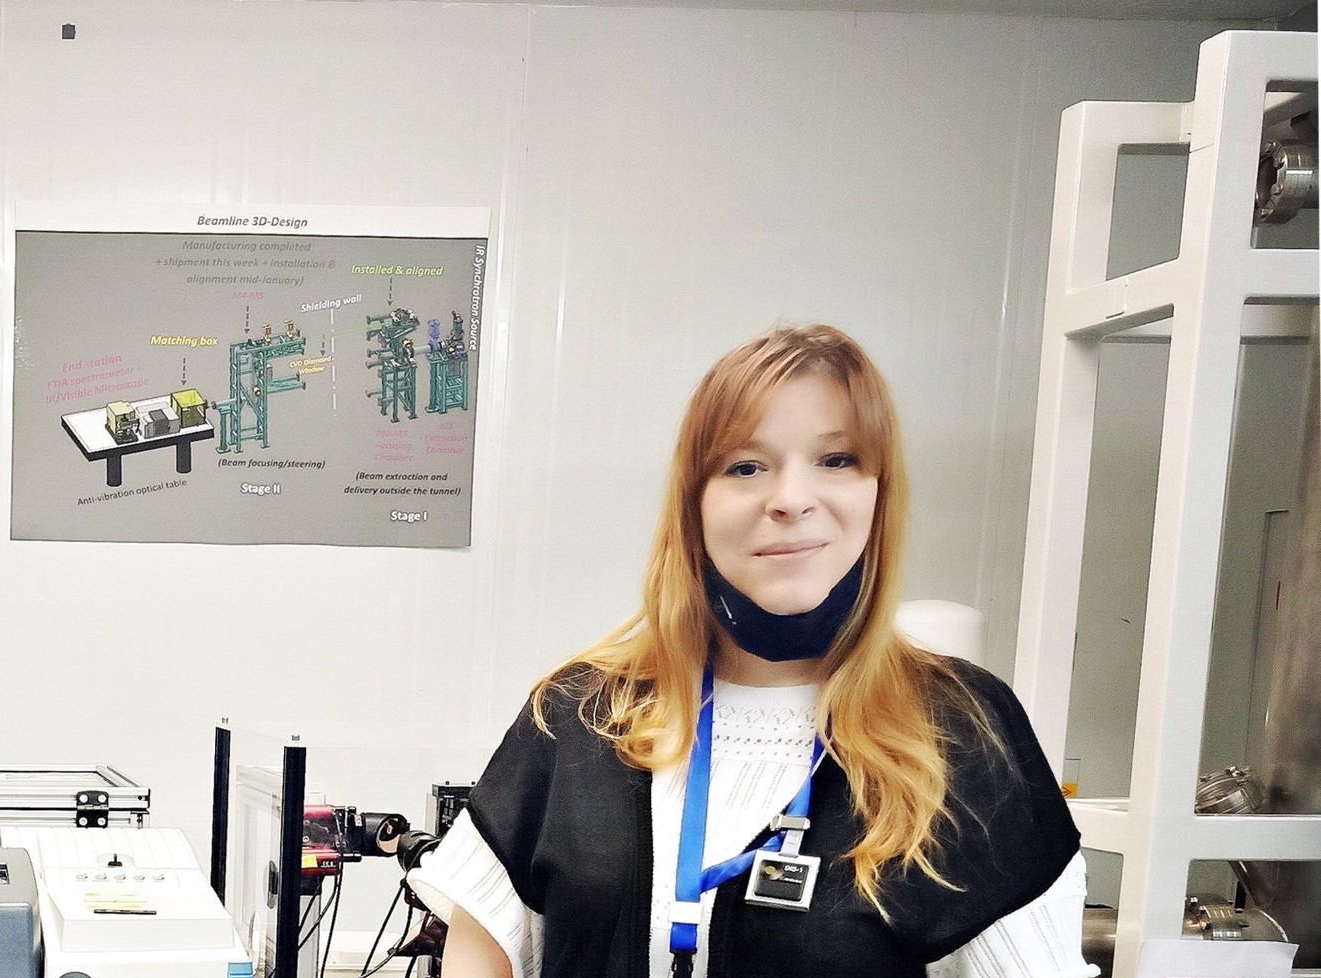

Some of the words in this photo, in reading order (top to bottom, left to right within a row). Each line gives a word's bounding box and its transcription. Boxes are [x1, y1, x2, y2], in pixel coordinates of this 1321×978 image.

[197, 216, 249, 226] Beamline
[252, 216, 308, 229] 3D-Design
[182, 241, 257, 252] Manufacturing
[259, 241, 311, 252] completed
[475, 245, 485, 256] IR
[163, 258, 210, 270] shipment
[213, 258, 230, 267] this
[233, 258, 259, 267] week
[270, 259, 325, 269] installation
[327, 260, 335, 269] &
[351, 265, 393, 275] Installed
[395, 265, 404, 275] &
[406, 266, 443, 277] aligned
[186, 275, 237, 286] alignment
[240, 275, 304, 287] mid-January)
[471, 256, 485, 316] Synchrotron
[301, 299, 340, 313] Shielding
[343, 294, 362, 305] wall
[469, 317, 480, 351] Source
[150, 335, 198, 347] Matching
[199, 335, 219, 346] box
[62, 361, 82, 372] End
[85, 354, 122, 369] station
[304, 355, 332, 365] Diamond
[70, 367, 134, 386] spectrometer
[298, 366, 325, 375] Window
[94, 377, 150, 394] Microscope
[218, 458, 246, 469] (Beam
[248, 458, 326, 470] focusing/steering)
[355, 471, 384, 481] (Beam
[385, 472, 429, 481] extraction
[430, 473, 448, 481] and
[77, 489, 135, 506] Anti-vibration
[136, 484, 165, 497] optical
[166, 479, 188, 490] table
[240, 482, 271, 495] Stage
[273, 483, 281, 494] II
[343, 486, 379, 496] delivery
[380, 487, 411, 495] outside
[413, 487, 428, 495] the
[429, 488, 462, 497] tunnel)
[390, 510, 421, 523] Stage
[423, 510, 428, 521] I
